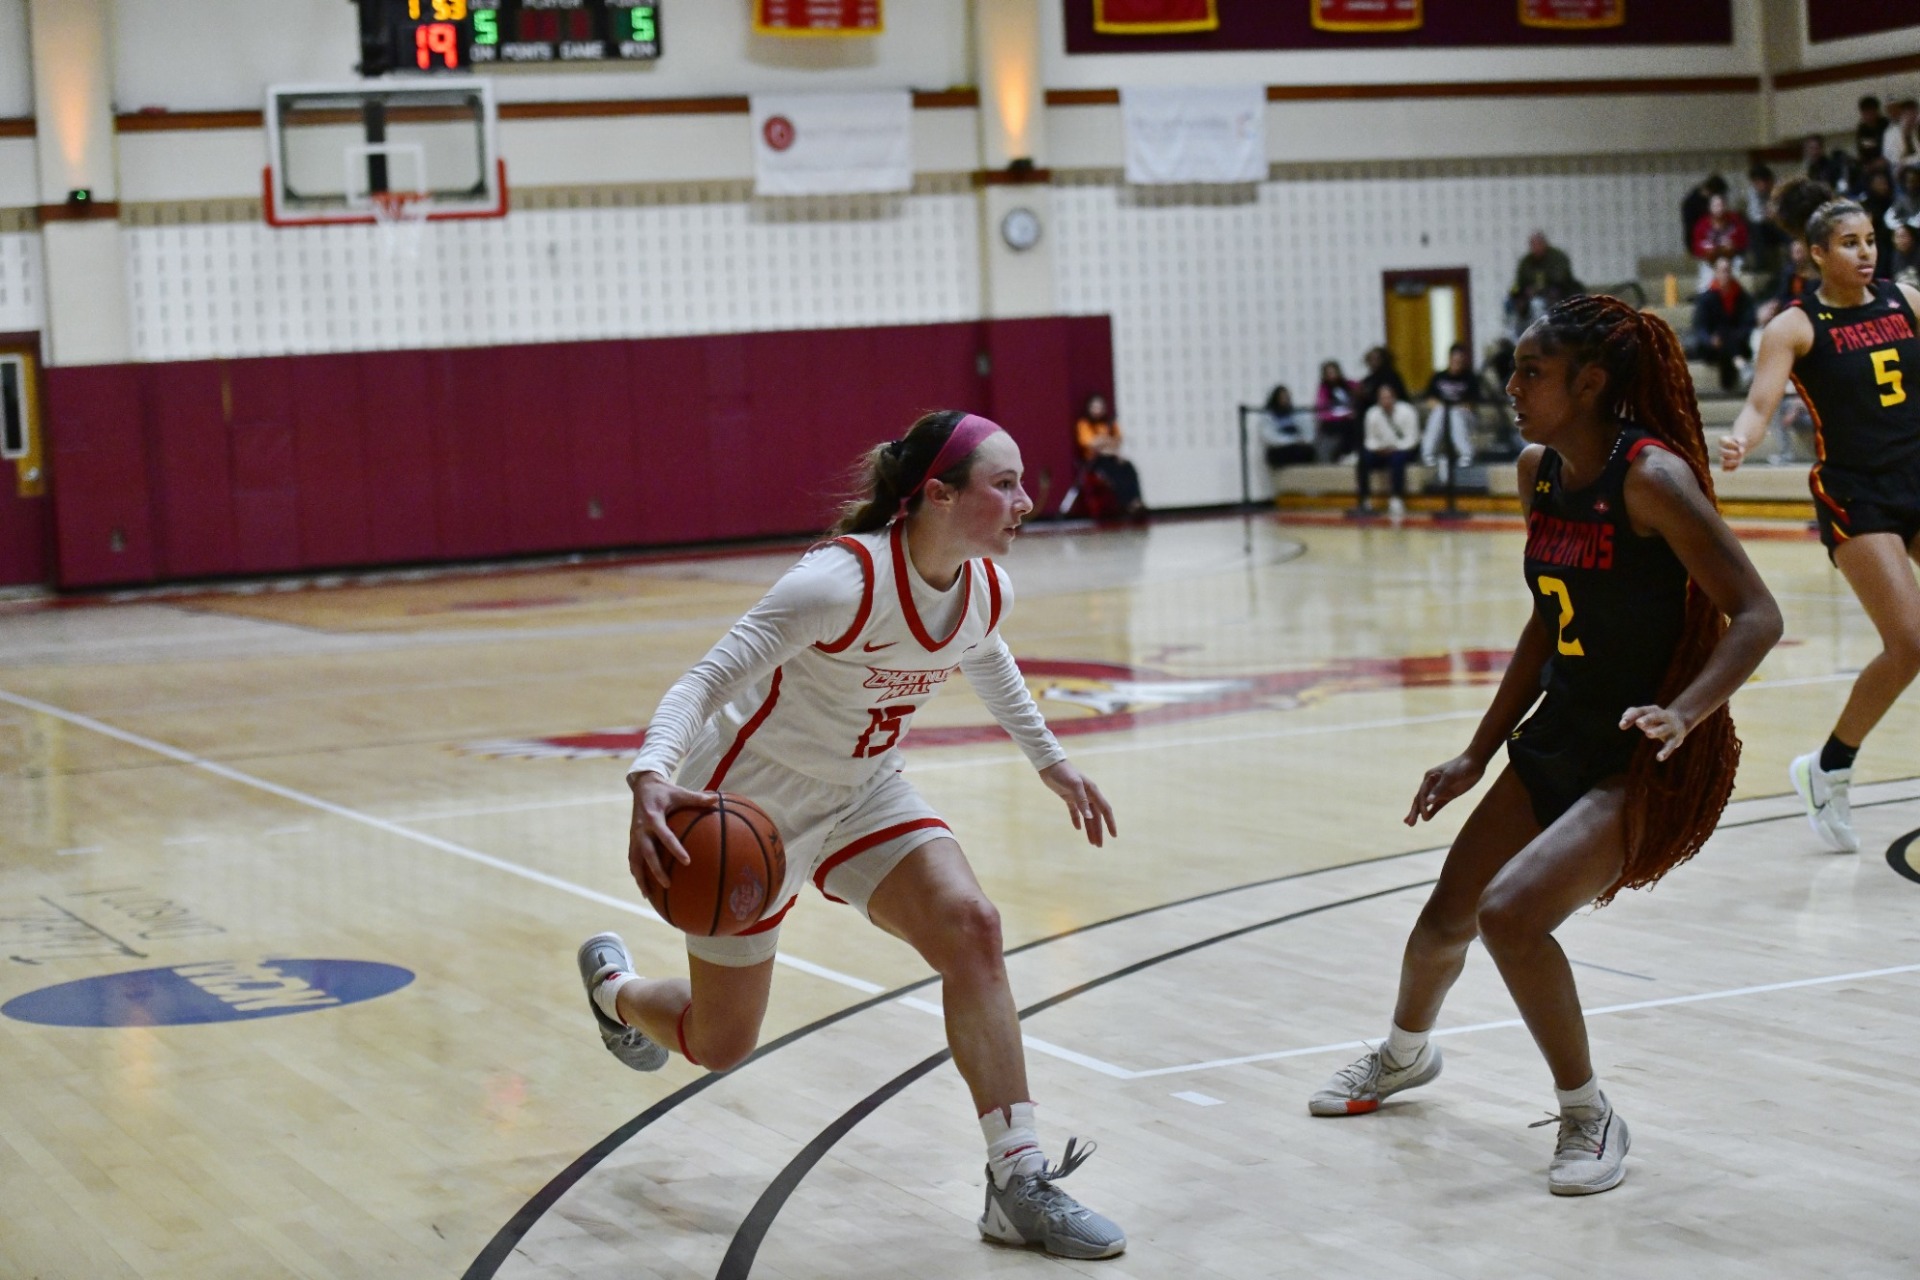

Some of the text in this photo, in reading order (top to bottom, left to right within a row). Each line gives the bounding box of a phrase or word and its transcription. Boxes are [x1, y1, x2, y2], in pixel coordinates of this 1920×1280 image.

[474, 9, 498, 45] 5
[631, 6, 656, 42] 5
[416, 23, 458, 70] 19
[501, 41, 606, 61] POINTS GAME
[1869, 347, 1907, 407] 5
[1537, 575, 1585, 656] 2
[863, 666, 951, 689] CHESTNU
[876, 684, 930, 703] HILL
[852, 704, 917, 758] 15
